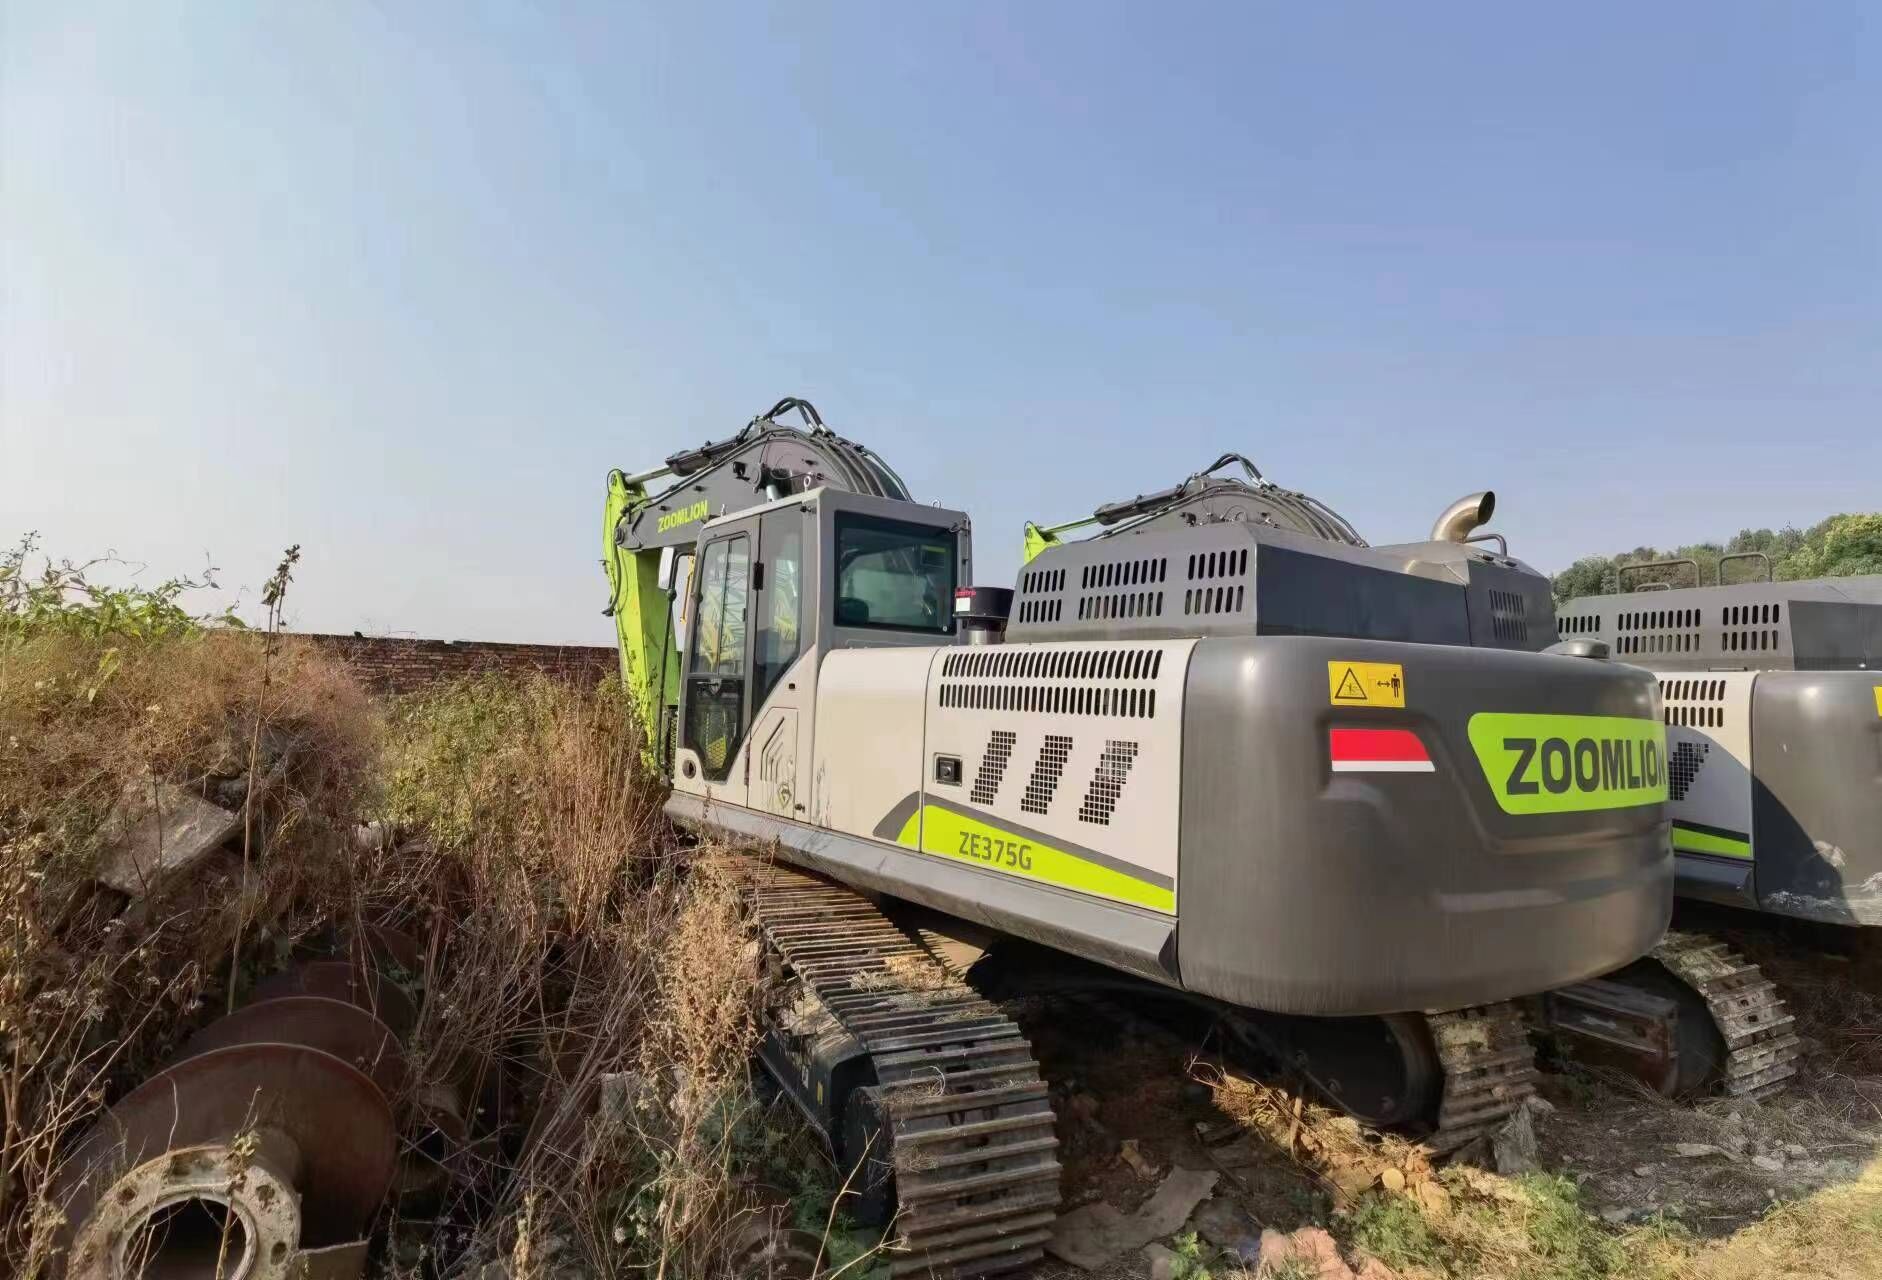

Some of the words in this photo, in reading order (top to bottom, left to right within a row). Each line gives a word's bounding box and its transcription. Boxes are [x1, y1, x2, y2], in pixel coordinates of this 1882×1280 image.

[657, 499, 708, 533] ZOOMLION
[1503, 737, 1667, 795] ZOOMLION
[959, 831, 1032, 870] ZE375G
